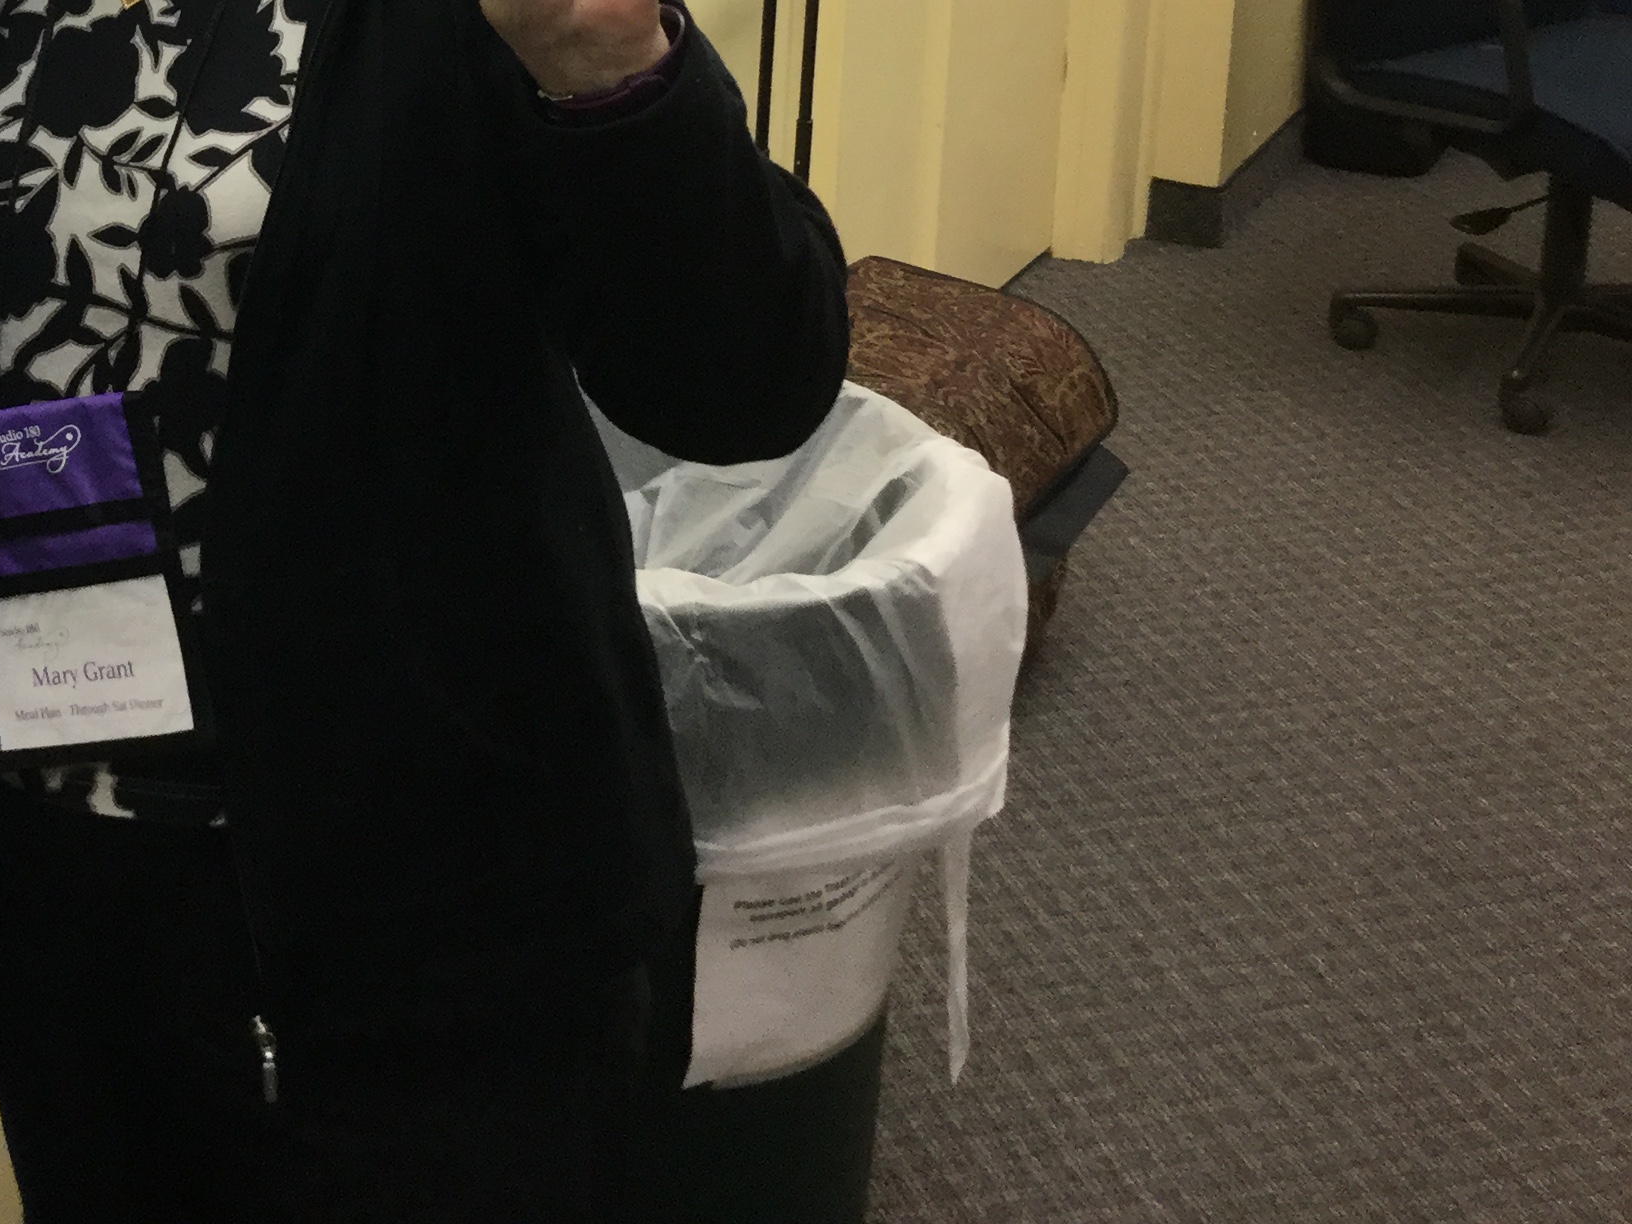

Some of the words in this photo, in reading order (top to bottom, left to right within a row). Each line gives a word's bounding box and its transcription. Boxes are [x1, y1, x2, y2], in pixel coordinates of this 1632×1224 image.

[24, 424, 41, 440] 180
[31, 664, 79, 689] Mary
[83, 660, 136, 683] Grant
